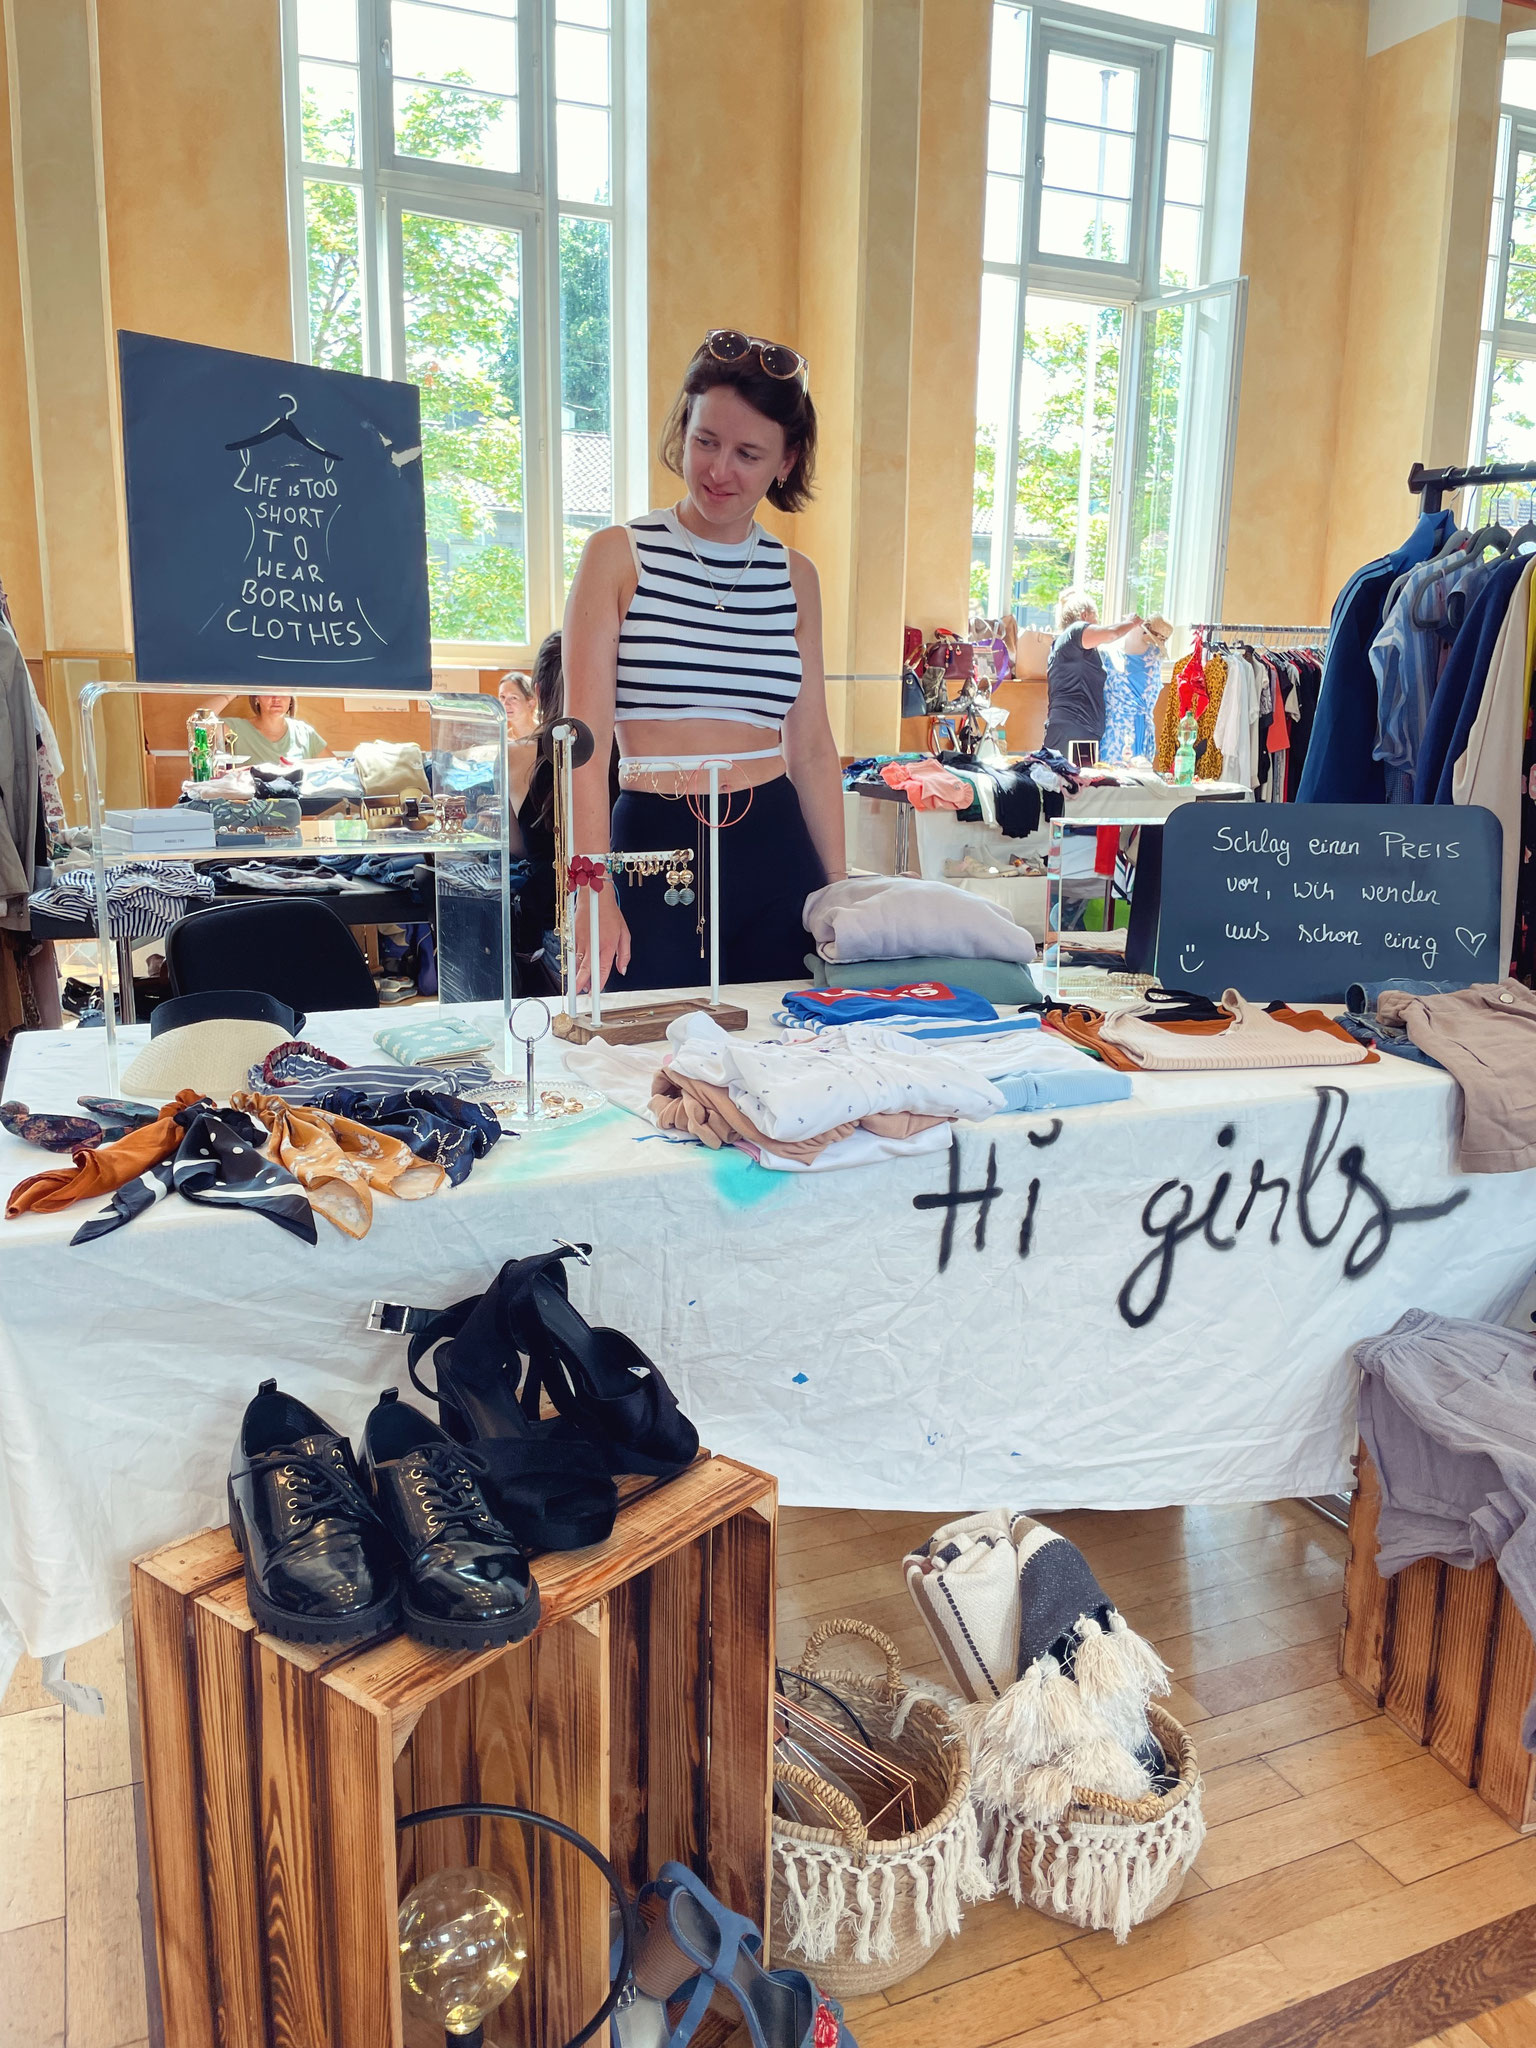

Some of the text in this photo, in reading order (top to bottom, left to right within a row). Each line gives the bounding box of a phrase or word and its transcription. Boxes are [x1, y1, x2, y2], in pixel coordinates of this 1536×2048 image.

[234, 467, 282, 498] LIFE
[300, 478, 338, 499] TOO
[256, 502, 324, 528] SHORT
[257, 557, 324, 583] WEAR
[241, 579, 344, 613] BORING
[226, 609, 362, 646] CLOTHES
[1213, 827, 1460, 867] Schlag einen PREIS
[1225, 875, 1441, 905] vor, wir werden
[1225, 919, 1438, 970] uns schon einig
[912, 1085, 1471, 1328] Hi girls
